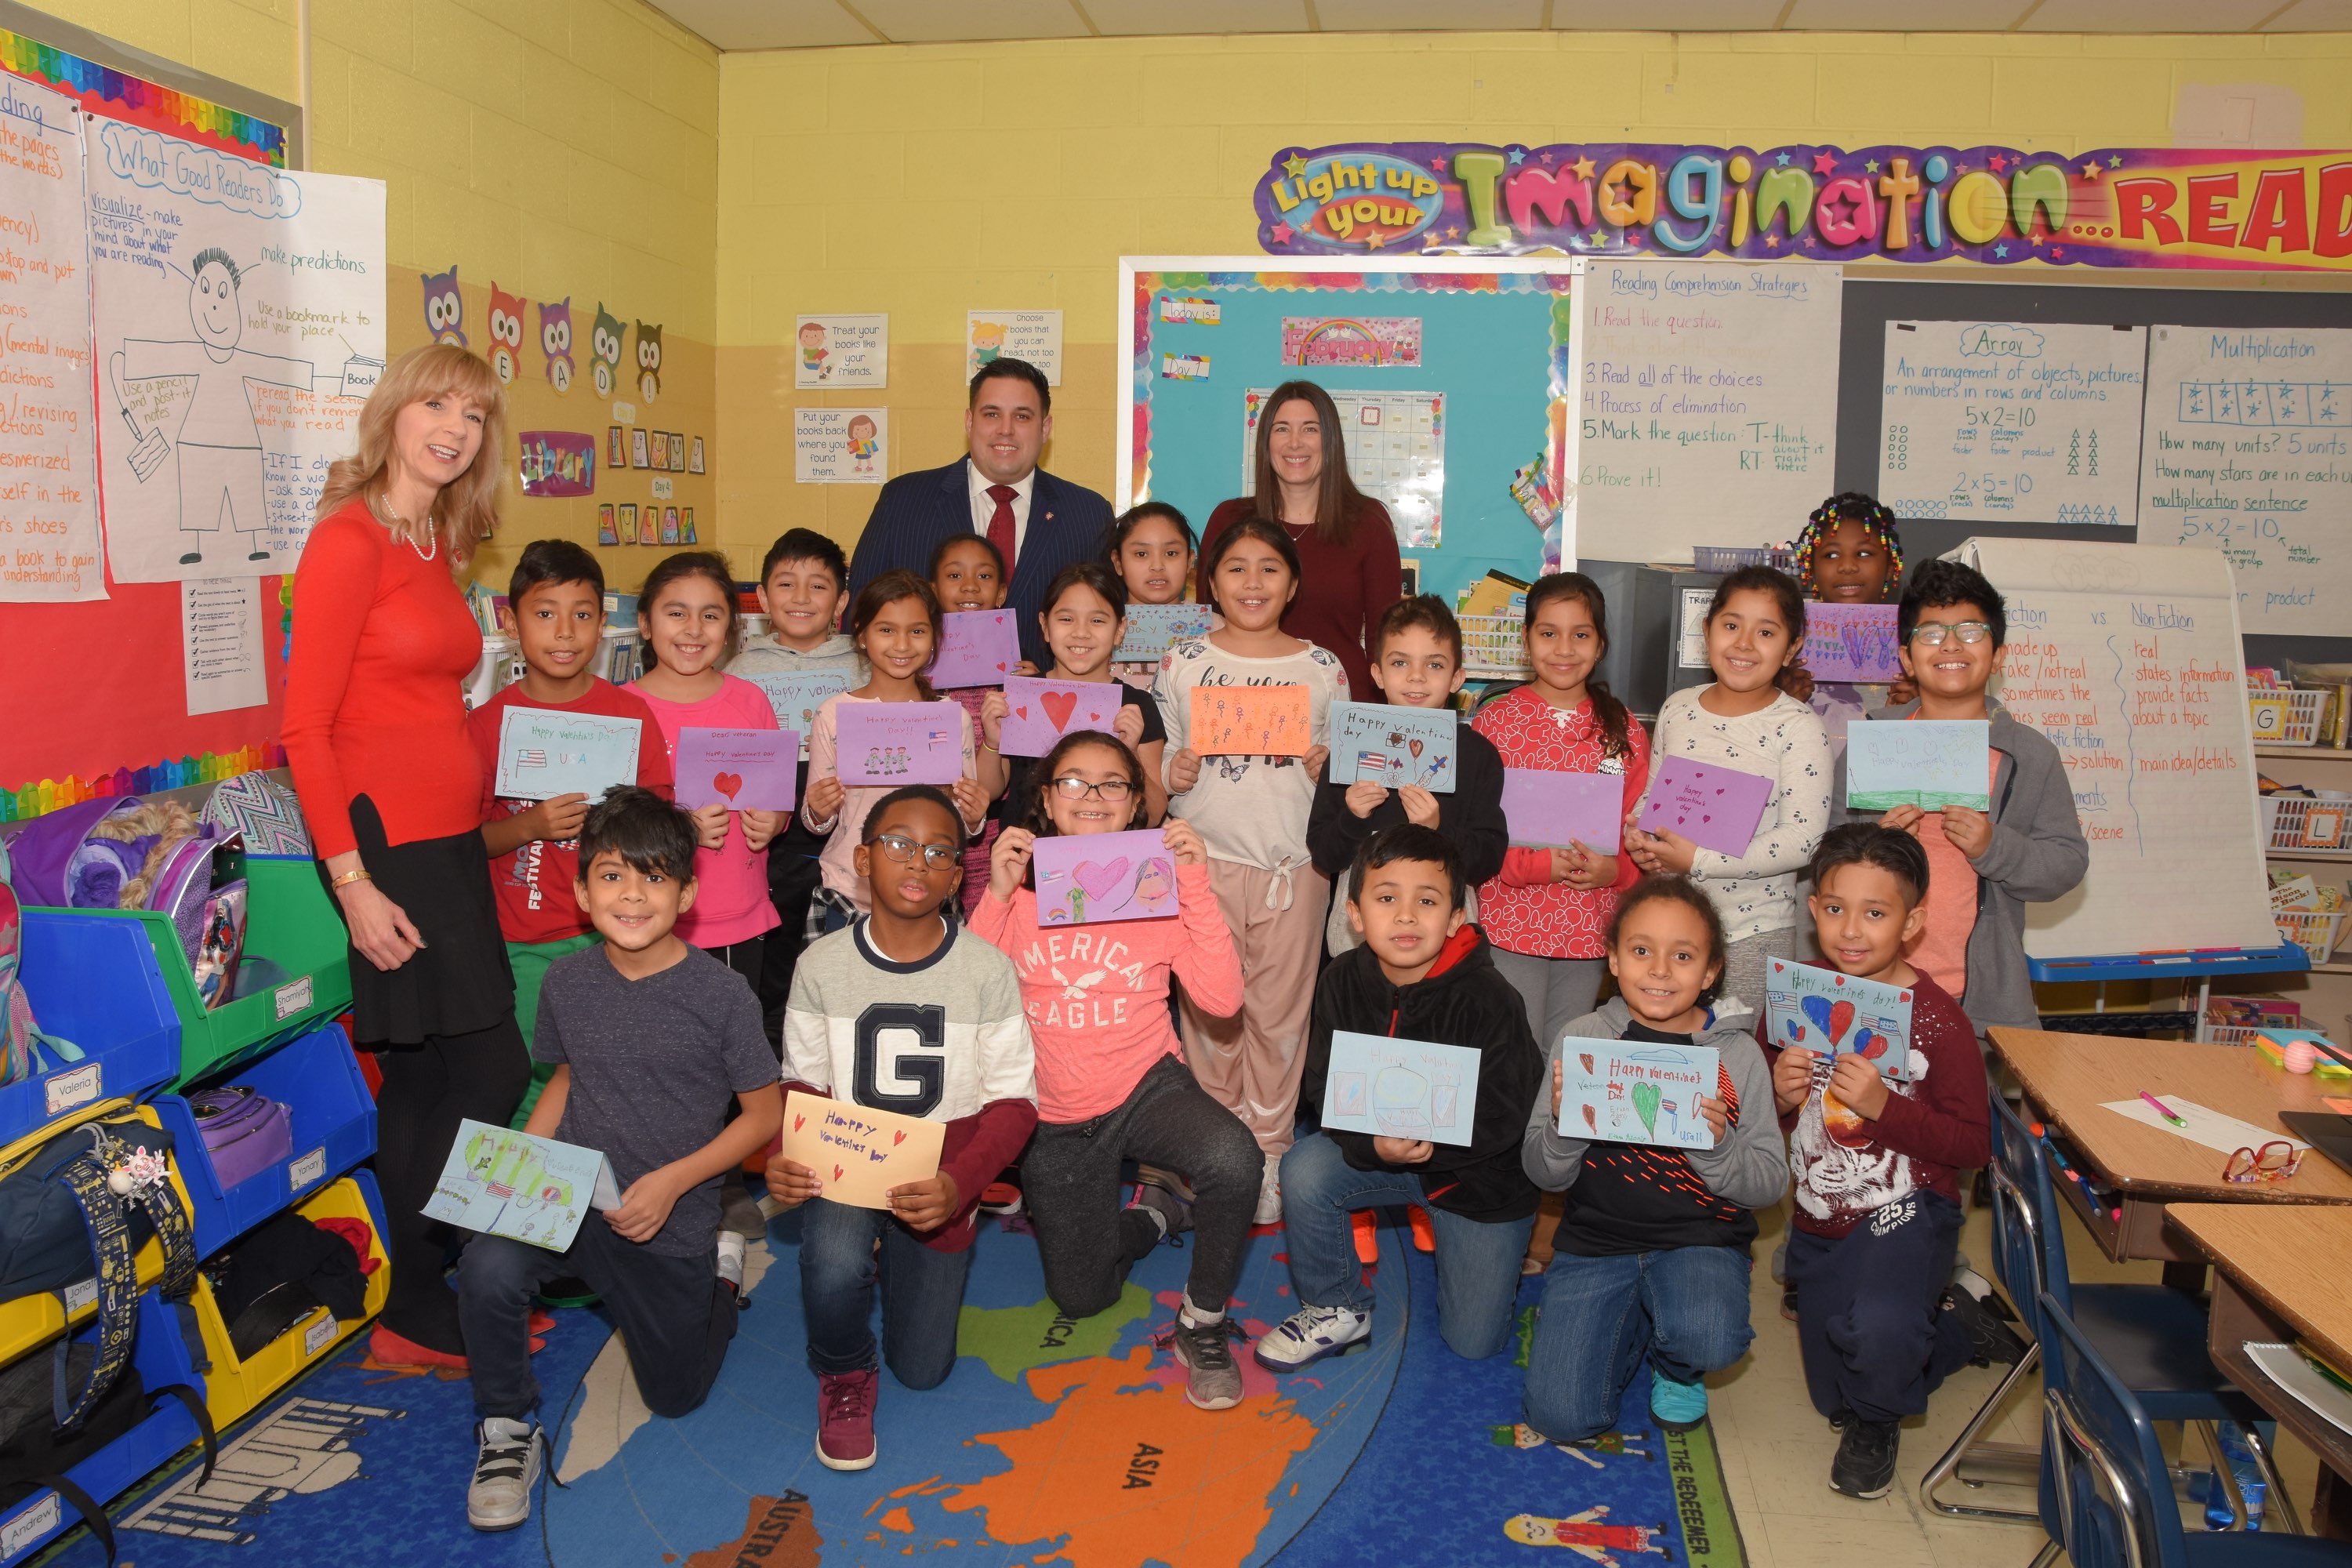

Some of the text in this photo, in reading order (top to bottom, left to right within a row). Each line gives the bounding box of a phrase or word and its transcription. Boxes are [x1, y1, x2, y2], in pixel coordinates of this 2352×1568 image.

[114, 132, 283, 207] What Good Readers Do
[1272, 161, 1438, 213] Light up
[92, 216, 133, 235] pictures
[154, 210, 183, 227] make
[1326, 199, 1425, 238] your
[125, 235, 145, 250] about
[291, 249, 365, 276] predictions
[1612, 269, 1807, 300] Reading Comprehension Strategies
[286, 308, 347, 325] bookmark
[1167, 302, 1198, 321] Today
[1605, 307, 1659, 327] Read the
[249, 314, 334, 341] hold place
[833, 326, 879, 338] Treat your
[836, 339, 876, 349] books like
[1014, 339, 1028, 347] you
[1286, 328, 1395, 359] February
[1975, 329, 2023, 356] Array
[2211, 335, 2315, 363] Multiplication
[845, 354, 865, 367] your
[1170, 358, 1189, 379] Day
[347, 374, 376, 386] Book
[839, 367, 871, 376] friends.
[1602, 363, 1762, 387] Read of the choices
[1897, 357, 2083, 388] An arrangement of objects,
[155, 376, 187, 393] pencil
[1904, 382, 2042, 401] numbers rows and
[296, 388, 317, 403] the
[1601, 390, 1746, 414] Process of elimination
[144, 407, 169, 424] notes
[306, 419, 345, 430] read
[820, 414, 840, 425] your
[1602, 419, 1808, 443] Mark the think
[829, 442, 845, 452] you
[2159, 430, 2281, 456] How many units?
[2155, 459, 2340, 486] How many stars each
[2152, 488, 2308, 512] multiplication sentence
[24, 515, 67, 535] shoes
[17, 549, 44, 566] book
[2288, 555, 2321, 564] number
[4, 567, 81, 592] understanding
[2266, 586, 2315, 614] product
[2134, 635, 2158, 659] real
[2136, 659, 2234, 682] states information
[766, 684, 802, 701] Happy
[2002, 681, 2091, 701] sometimes the
[2137, 682, 2209, 706] provide facts
[1348, 713, 1386, 729] Happy
[2132, 706, 2209, 731] about topic
[2258, 709, 2273, 729] G
[1344, 726, 1361, 739] day
[2081, 750, 2123, 771] solution
[1683, 784, 1703, 797] Happy
[2270, 888, 2300, 903] Bison
[2276, 886, 2292, 895] The
[2281, 890, 2310, 906] Back!
[277, 985, 310, 1007] Shamiyah
[1028, 997, 1127, 1029] EAGLE
[852, 1003, 945, 1117] G
[59, 1077, 91, 1096] Valeria
[1871, 1201, 1916, 1237] CHAMPIONS
[1878, 1199, 1903, 1225] 25
[1122, 1443, 1164, 1490] ASIA
[1672, 1449, 1693, 1474] THE
[11, 1506, 53, 1543] Andrew
